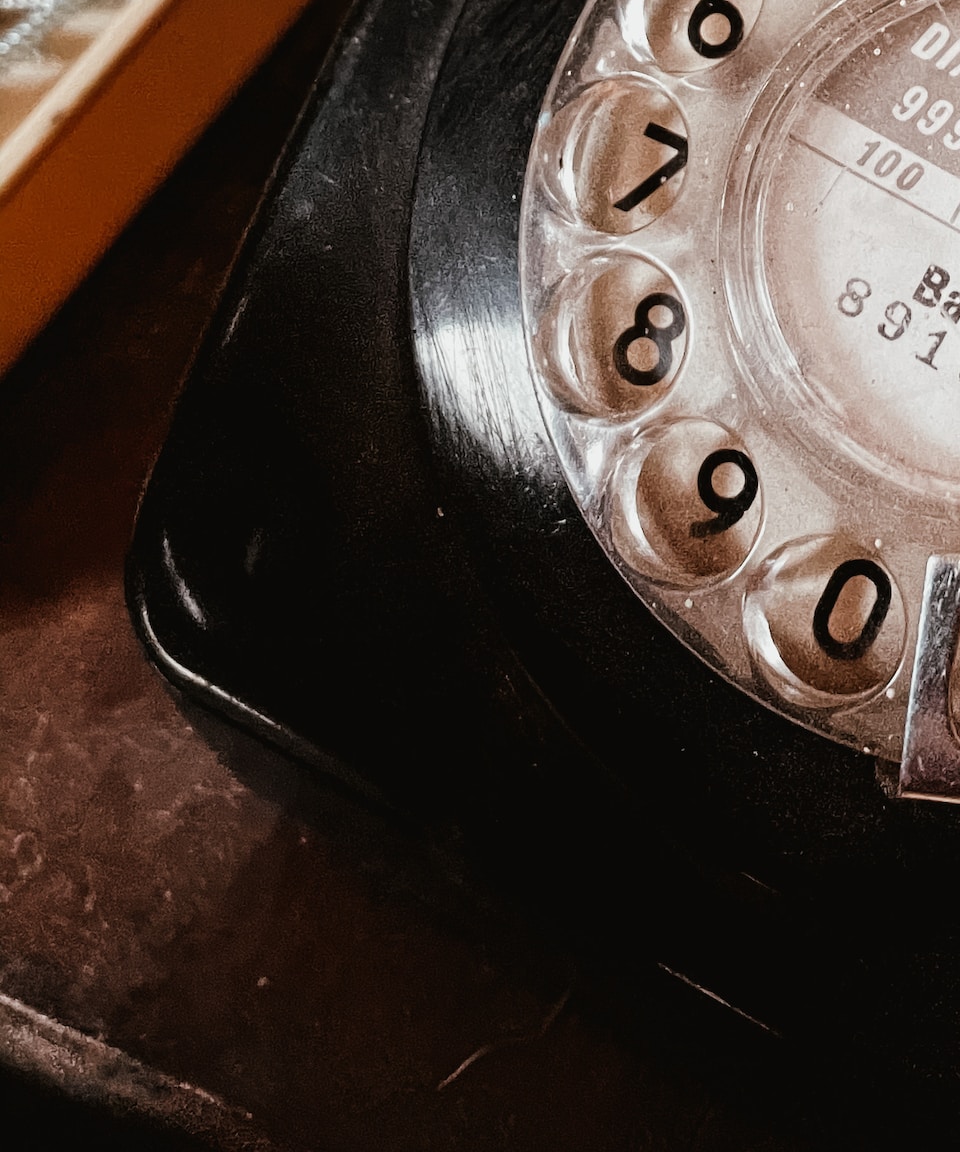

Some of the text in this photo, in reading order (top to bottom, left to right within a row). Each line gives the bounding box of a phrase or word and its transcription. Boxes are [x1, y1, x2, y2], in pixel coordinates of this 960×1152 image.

[613, 122, 688, 212] 7
[856, 140, 925, 191] 100
[613, 292, 685, 386] 8
[690, 449, 758, 538] 9
[813, 559, 892, 660] 0
